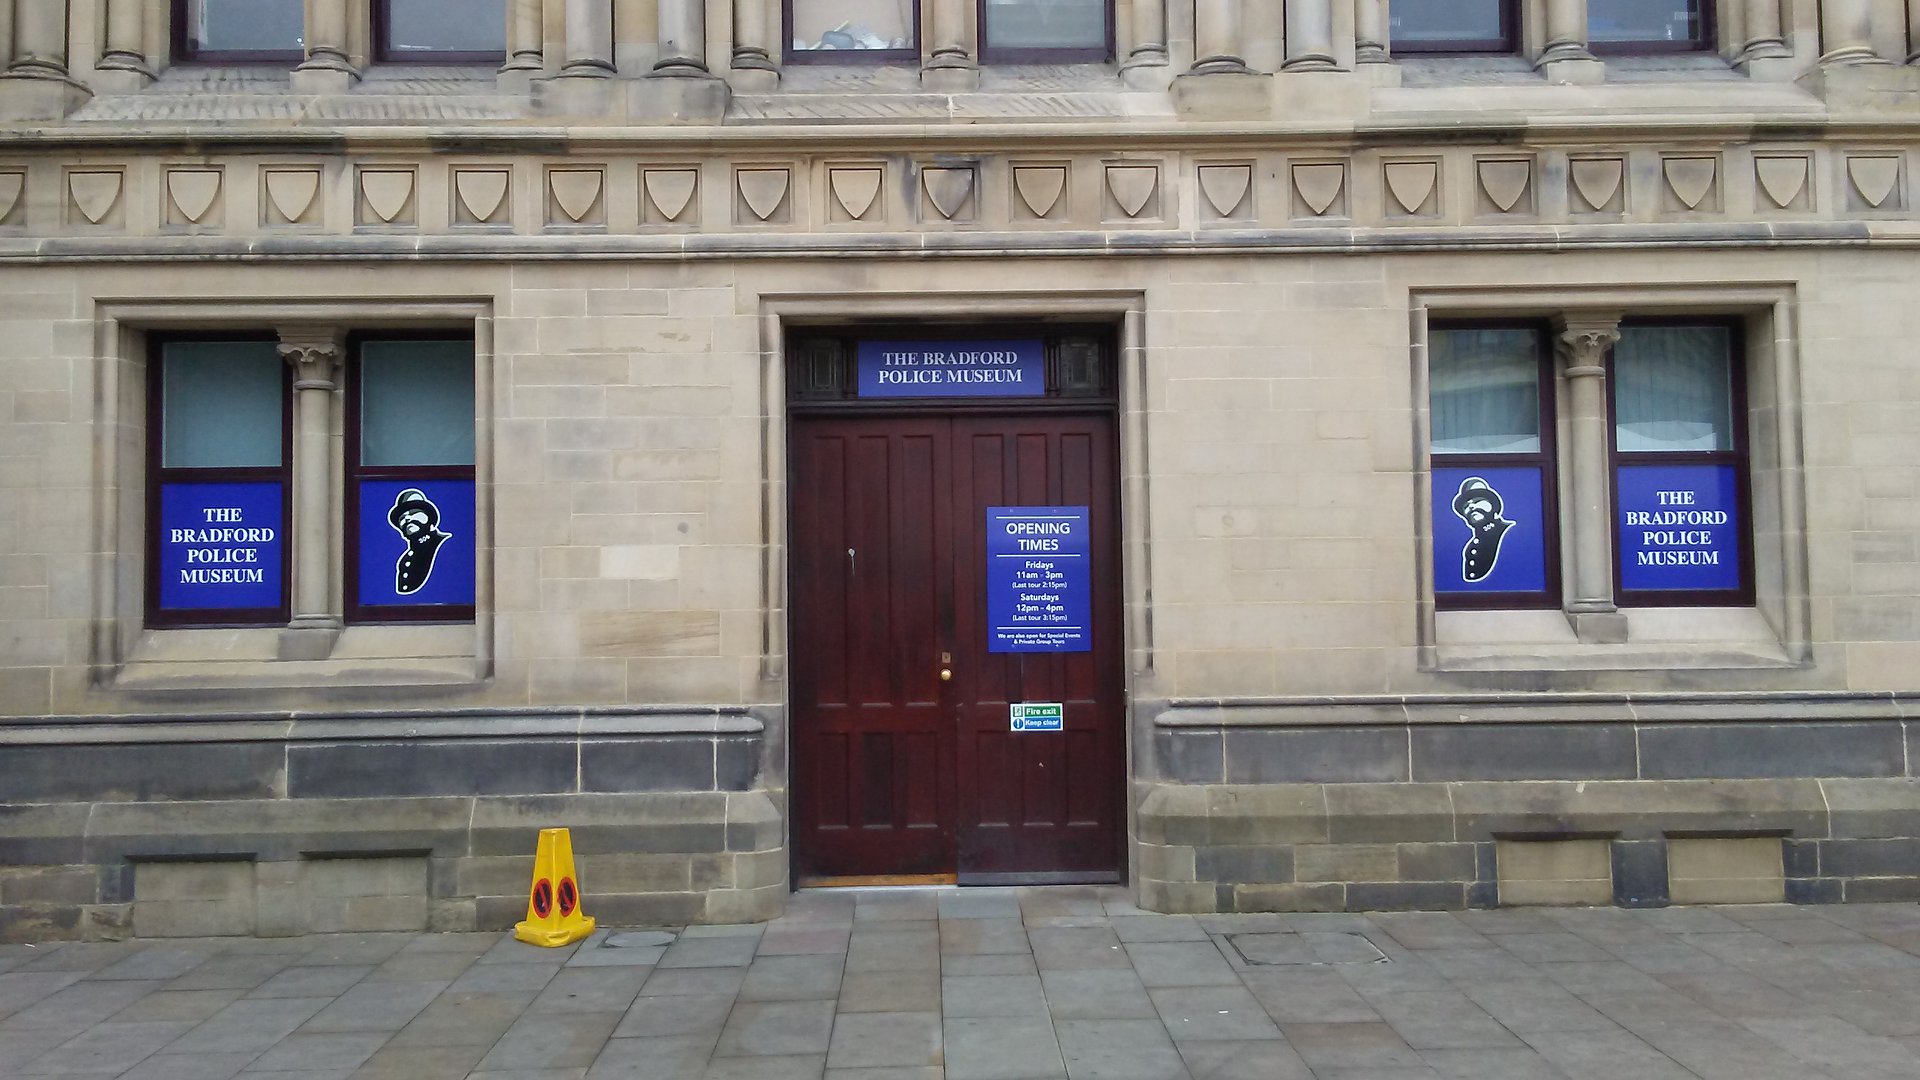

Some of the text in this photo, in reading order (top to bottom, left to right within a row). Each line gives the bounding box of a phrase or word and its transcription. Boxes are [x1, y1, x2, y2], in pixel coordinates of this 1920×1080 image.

[883, 352, 1017, 365] THE BRADFORD
[879, 369, 1022, 383] POLICE MUSEUM
[1656, 491, 1695, 505] THE
[203, 508, 243, 522] THE
[1626, 511, 1727, 525] BRADFORD
[1005, 522, 1071, 535] OPENING
[170, 528, 274, 543] BRADFORD
[1643, 531, 1712, 545] POLICE
[1017, 539, 1059, 551] TIMES
[186, 549, 257, 563] POLICE
[1637, 551, 1719, 565] MUSEUM
[1025, 561, 1054, 570] Fridays
[180, 568, 264, 583] MUSEUM
[1016, 571, 1038, 579] 11am
[1045, 571, 1063, 580] 3pm
[1042, 581, 1067, 589] 2:15pm)
[1020, 593, 1059, 602] Saturdays
[1016, 604, 1039, 613] 12pm
[1045, 604, 1064, 613] 4pm
[1042, 614, 1067, 622] 3:15pm)
